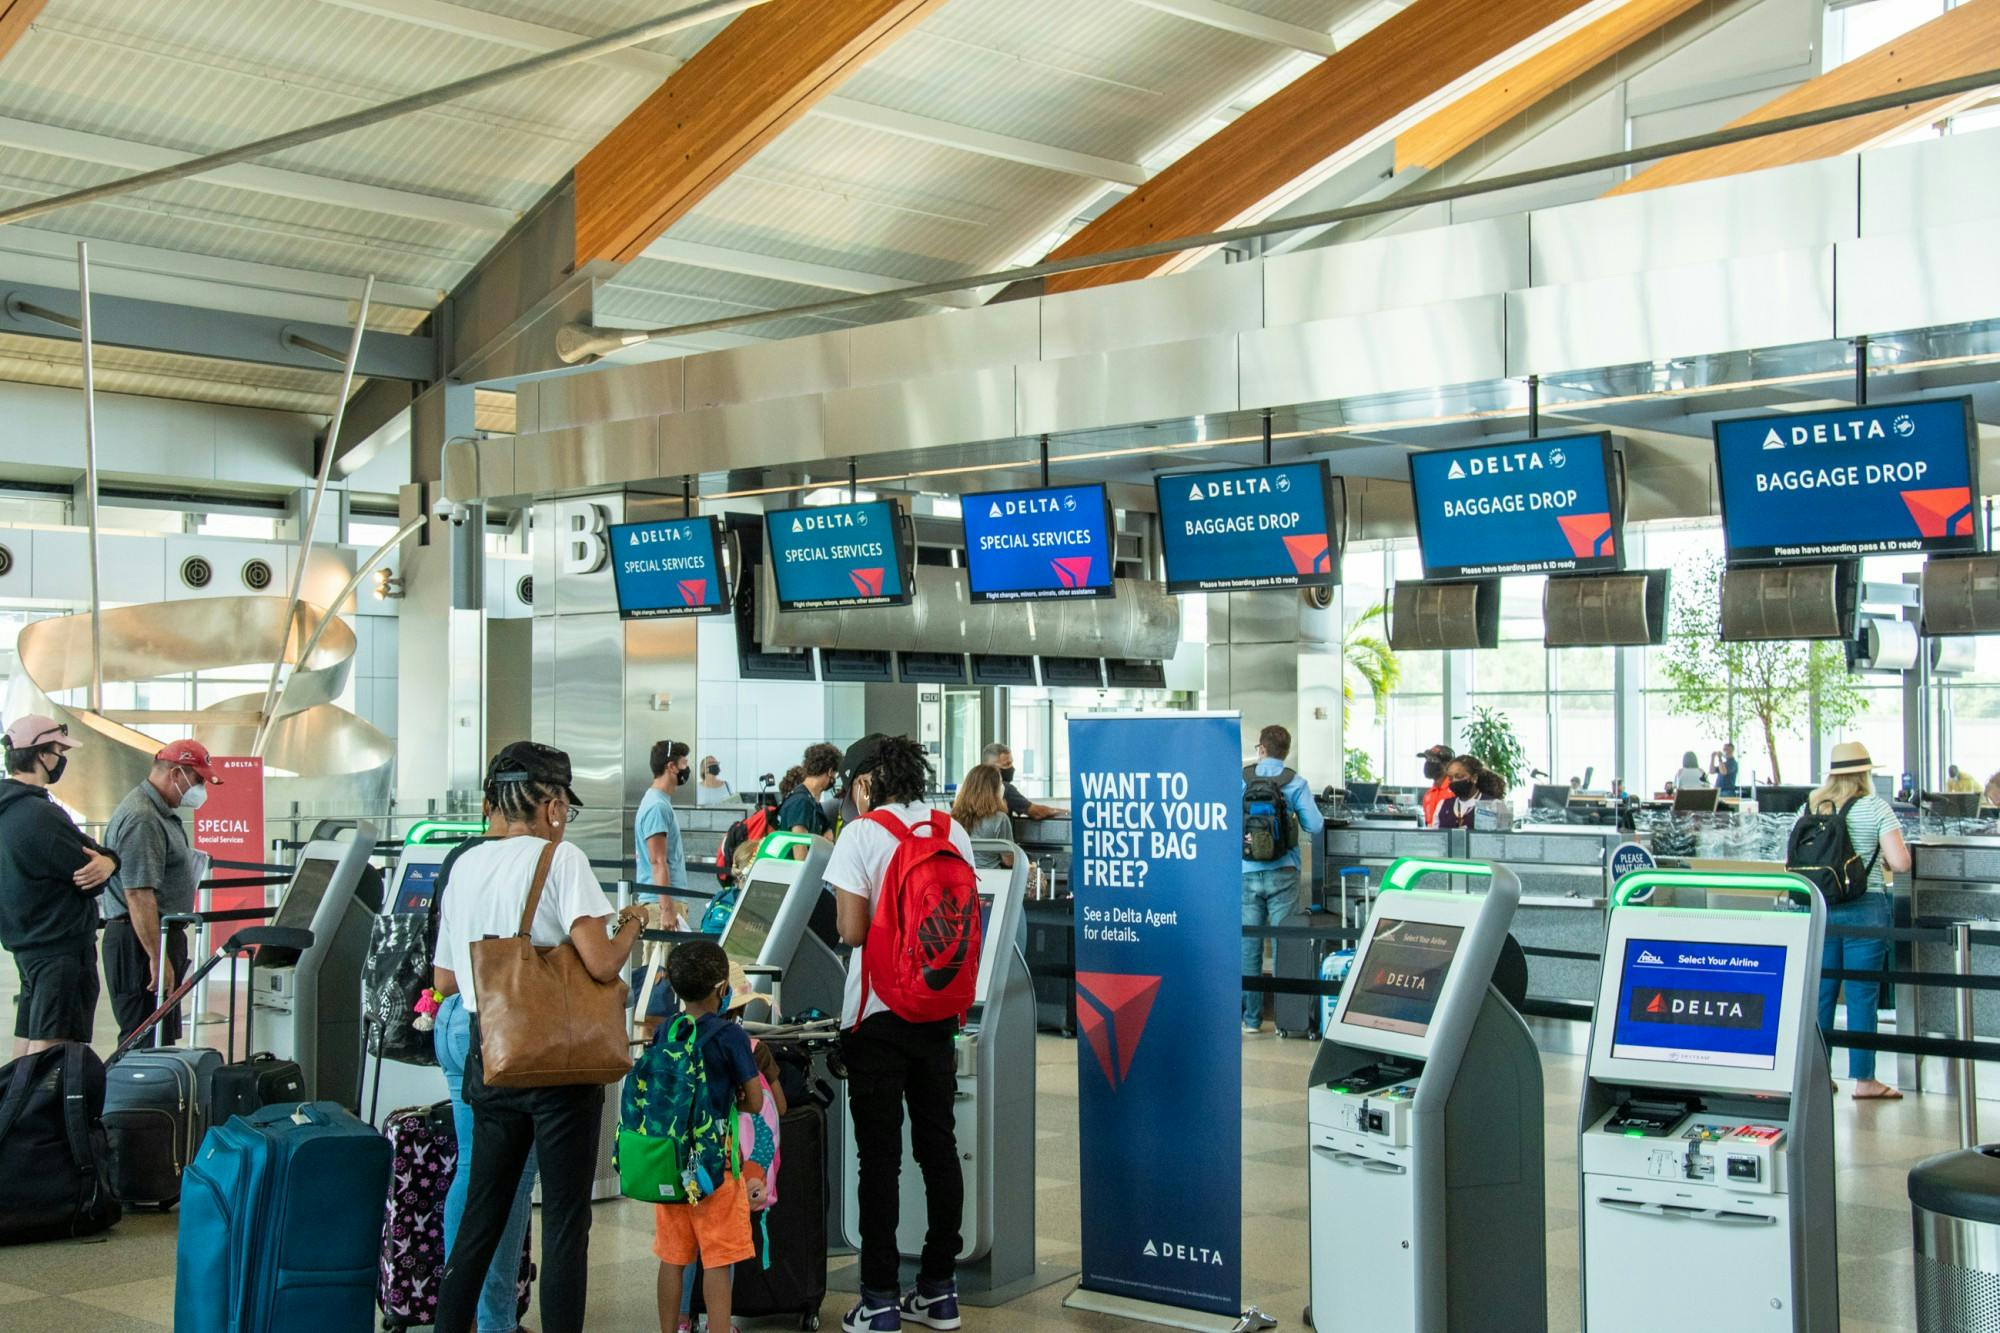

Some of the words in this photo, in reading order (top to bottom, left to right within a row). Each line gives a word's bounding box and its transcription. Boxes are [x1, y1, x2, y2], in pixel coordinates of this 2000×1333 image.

[1792, 420, 1885, 445] DELTA
[1470, 452, 1543, 475] DELTA
[1756, 466, 1859, 492] BAGGAGE
[1866, 461, 1927, 484] DROP
[1208, 478, 1270, 497] DELTA
[1006, 498, 1060, 514] DELTA
[1444, 495, 1524, 517] BAGGAGE
[1530, 490, 1577, 510] DROP
[806, 514, 853, 529] DELTA
[1185, 516, 1255, 536] BAGGAGE
[1259, 512, 1299, 530] DROP
[563, 503, 604, 574] B
[642, 528, 680, 543] DELTA
[980, 534, 1029, 550] SPECIAL
[1033, 530, 1091, 547] SERVICES
[785, 548, 829, 562] SPECIAL
[831, 543, 882, 559] SERVICES
[1775, 547, 1800, 555] Please
[1802, 546, 1820, 554] have
[1822, 544, 1857, 553] boarding
[1859, 544, 1878, 552] pass
[1880, 542, 1886, 550] &
[1888, 541, 1896, 549] ID
[1899, 540, 1922, 550] ready
[625, 560, 660, 574] SPECIAL
[662, 556, 705, 571] SERVICES
[1498, 564, 1525, 572] boarding
[1558, 560, 1575, 569] ready
[1080, 772, 1150, 800] WANT
[1157, 772, 1188, 800] TO
[198, 820, 249, 832] SPECIAL
[1082, 802, 1155, 830] CHECK
[1161, 802, 1228, 831] YOUR
[1084, 831, 1144, 858] FIRST
[1151, 832, 1197, 859] BAG
[1621, 853, 1644, 863] PLEASE
[1084, 860, 1148, 887] FREE?
[1084, 906, 1101, 921] See
[1104, 911, 1110, 921] a
[1113, 907, 1142, 923] Delta
[1145, 908, 1177, 927] Agent
[1084, 924, 1098, 940] for
[1101, 926, 1140, 942] details.
[1678, 954, 1705, 964] Select
[1708, 956, 1727, 966] Your
[1729, 958, 1759, 968] Airline
[1387, 972, 1425, 990] DELTA
[1672, 999, 1743, 1018] DELTA
[1163, 1242, 1223, 1266] DELTA
